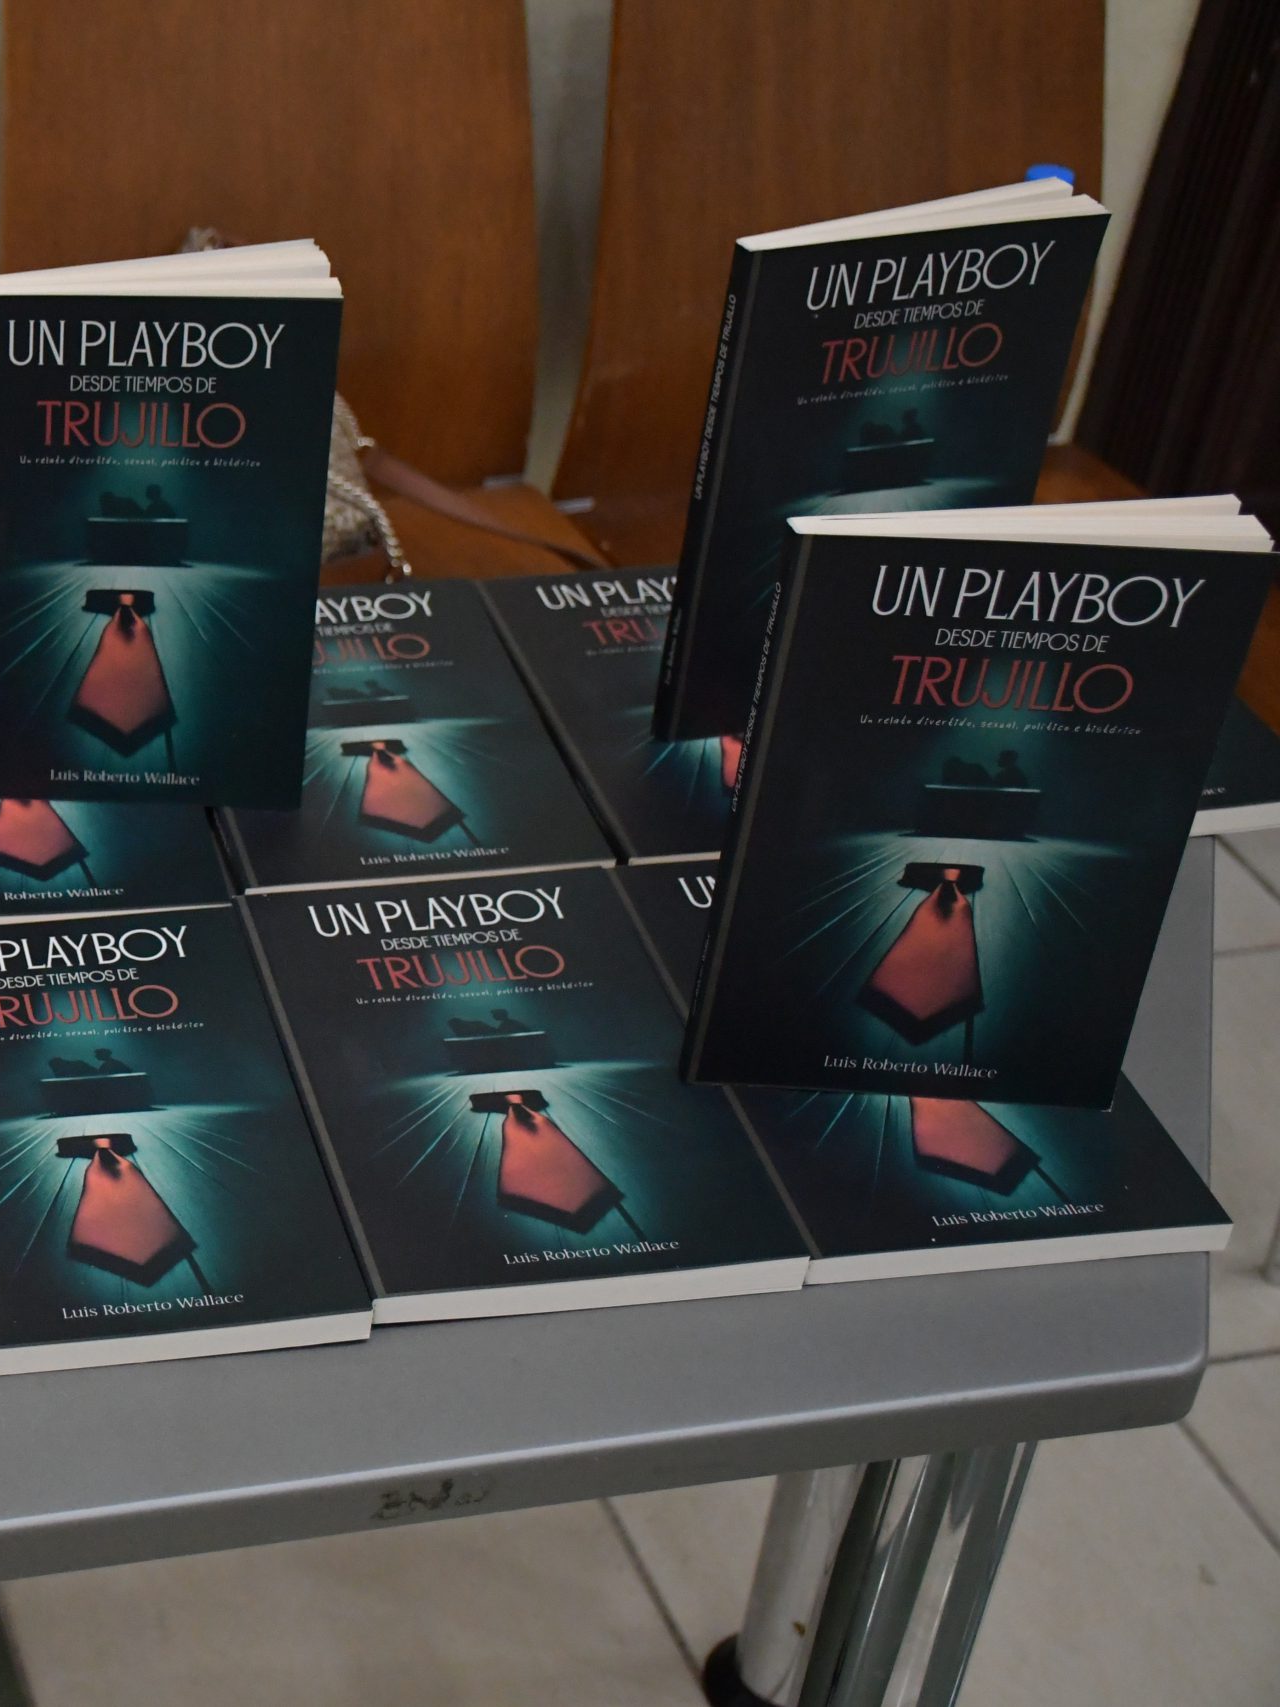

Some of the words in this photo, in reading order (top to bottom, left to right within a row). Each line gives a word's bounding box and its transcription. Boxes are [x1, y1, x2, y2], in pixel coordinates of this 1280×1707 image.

[807, 262, 862, 310] UN
[868, 241, 1055, 303] PLAYBOY
[854, 309, 900, 329] DESDE
[904, 302, 963, 323] TIEMPOS
[964, 299, 984, 316] DE
[9, 320, 65, 366] UN
[80, 321, 284, 368] PLAYBOY
[822, 322, 1004, 384] TRUJILLO
[70, 375, 120, 392] DESDE
[125, 376, 192, 393] TIEMPOS
[196, 377, 216, 393] DE
[36, 399, 247, 449] TRUJILLO
[535, 582, 592, 610] UN
[592, 576, 677, 606] PLAY
[873, 565, 946, 616] UN
[952, 568, 1205, 627] PLAYBOY
[314, 591, 433, 625] AYBOY
[935, 628, 996, 647] DESDE
[1001, 631, 1080, 651] TIEMPOS
[1082, 635, 1110, 652] DE
[891, 654, 1134, 715] TRUJILLO
[51, 769, 79, 781] Luis
[84, 770, 140, 782] Roberto
[145, 772, 199, 784] Wallace
[360, 857, 390, 865] Luis
[393, 852, 451, 862] Roberto
[453, 848, 508, 857] Wallace
[4, 891, 62, 900] Roberto
[67, 888, 123, 897] Wallace
[308, 903, 370, 937] UN
[375, 887, 563, 933] PLAYBOY
[381, 936, 431, 951] DESDE
[431, 931, 499, 946] TIEMPOS
[499, 929, 522, 941] DE
[47, 970, 115, 985] TIEMPOS
[117, 968, 139, 981] DE
[356, 945, 566, 992] TRUJILLO
[824, 1056, 856, 1068] Luis
[863, 1058, 927, 1072] Roberto
[934, 1063, 997, 1077] Wallace
[932, 1215, 968, 1226] Luis
[970, 1209, 1037, 1223] Roberto
[1038, 1204, 1103, 1216] Wallace
[504, 1253, 539, 1264] Luis
[543, 1248, 610, 1261] Roberto
[613, 1242, 678, 1254] Wallace
[63, 1307, 98, 1319] Luis
[103, 1301, 171, 1315] Roberto
[176, 1295, 243, 1308] Wallace
